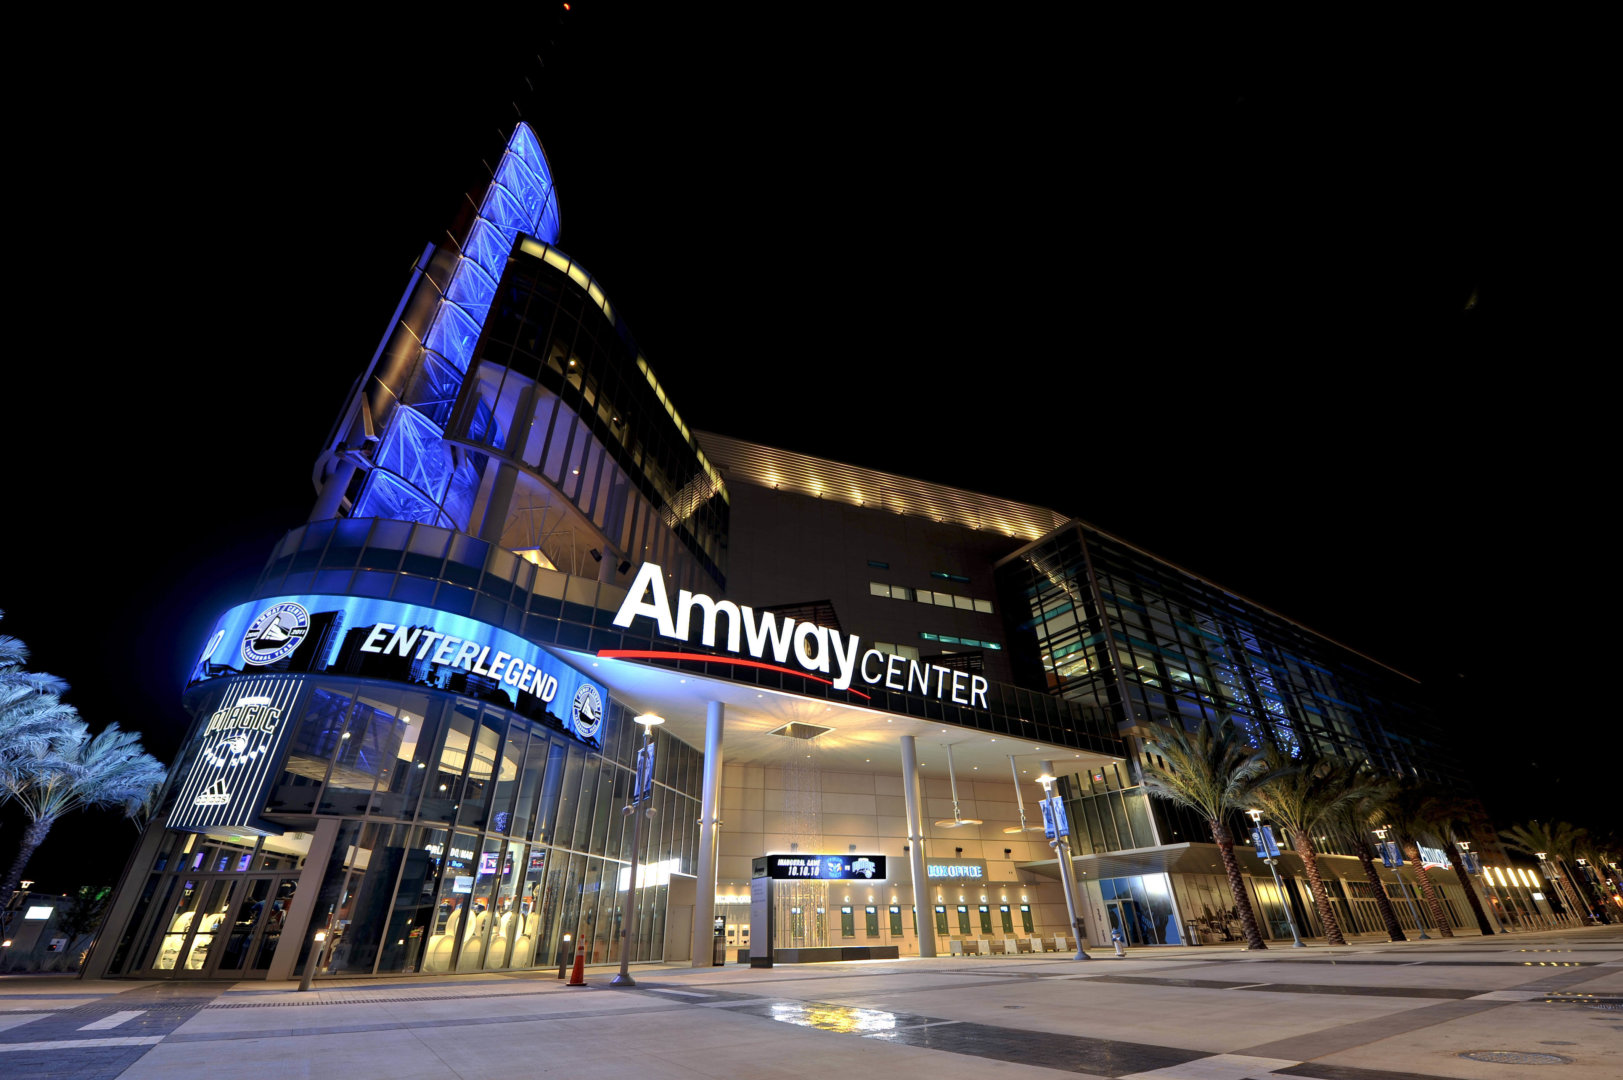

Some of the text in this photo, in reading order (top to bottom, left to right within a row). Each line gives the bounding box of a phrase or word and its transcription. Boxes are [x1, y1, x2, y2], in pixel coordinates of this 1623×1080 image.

[612, 561, 988, 709] Amway CENTER
[203, 704, 281, 737] MAGIC
[777, 858, 805, 866] INAUGURAL
[787, 866, 820, 876] 10.10.10
[927, 865, 983, 877] BOX OFFICE
